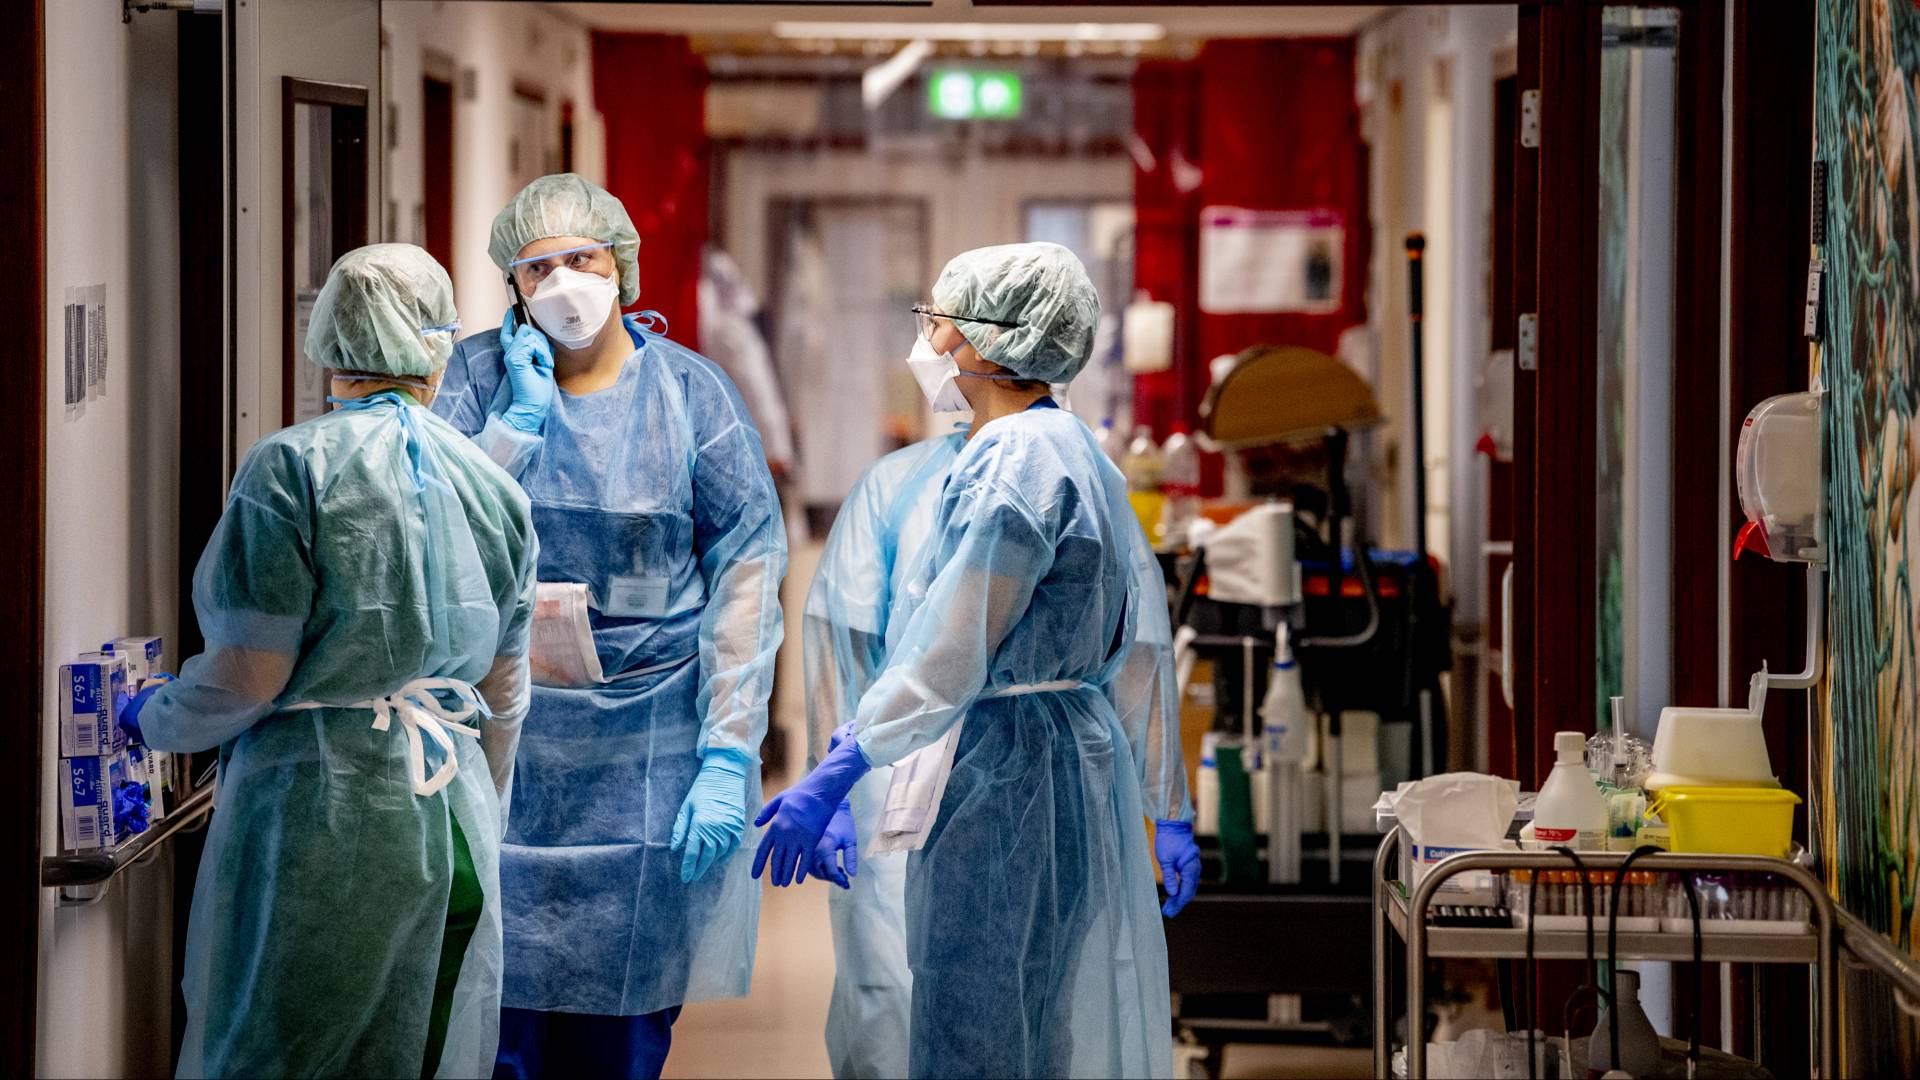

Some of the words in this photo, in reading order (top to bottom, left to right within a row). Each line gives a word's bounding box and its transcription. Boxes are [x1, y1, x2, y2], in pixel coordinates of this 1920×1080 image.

[565, 315, 581, 323] 3M
[73, 675, 85, 683] S
[74, 684, 86, 704] 6-7
[147, 748, 155, 774] ALYARD
[73, 768, 84, 776] S
[73, 777, 86, 796] 6-7
